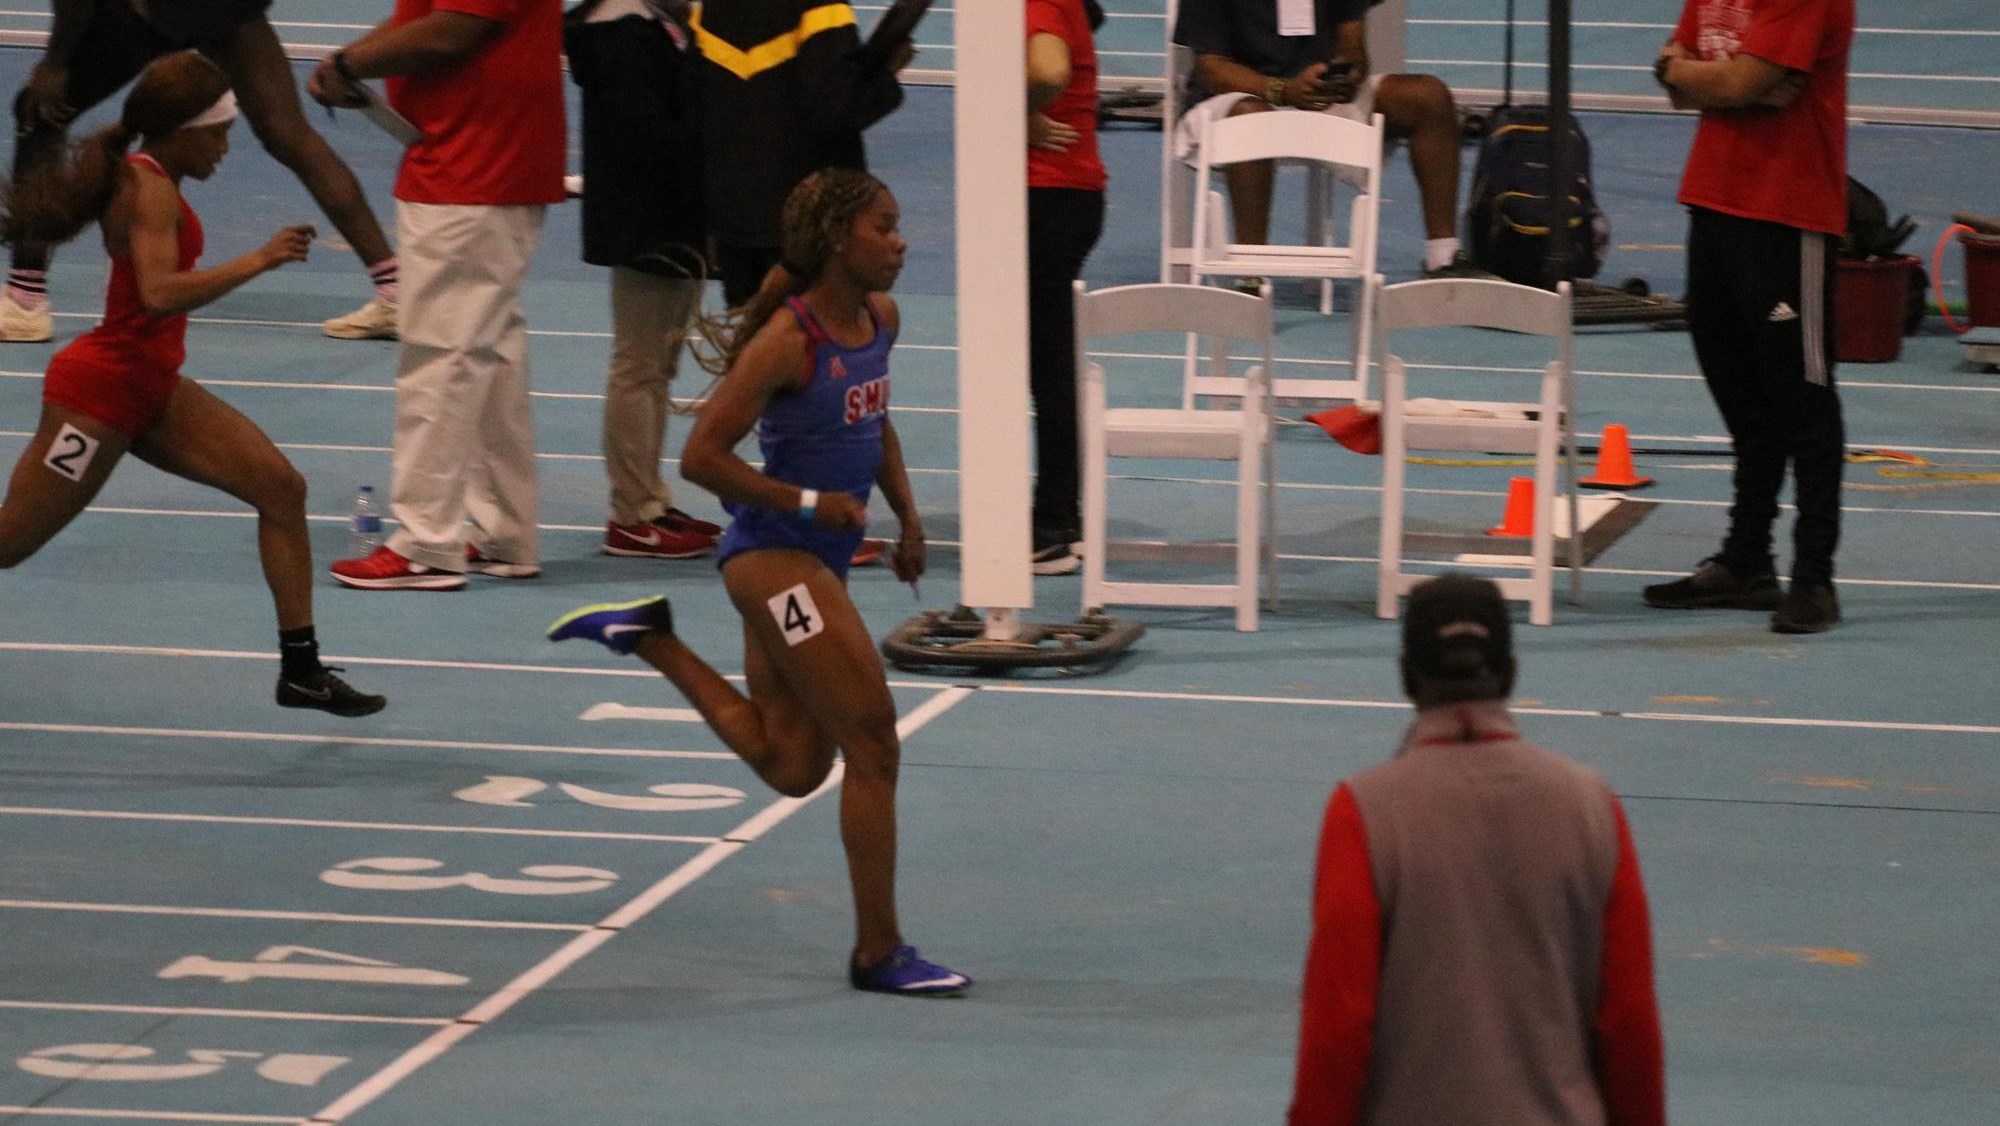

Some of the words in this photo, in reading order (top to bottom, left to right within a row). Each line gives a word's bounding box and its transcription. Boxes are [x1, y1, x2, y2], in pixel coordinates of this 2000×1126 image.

[51, 433, 86, 475] 2
[785, 593, 811, 633] 4
[577, 702, 704, 722] 1
[452, 775, 748, 812] 2
[320, 856, 620, 895] 3
[157, 945, 471, 986] 4
[16, 1043, 351, 1086] 5
